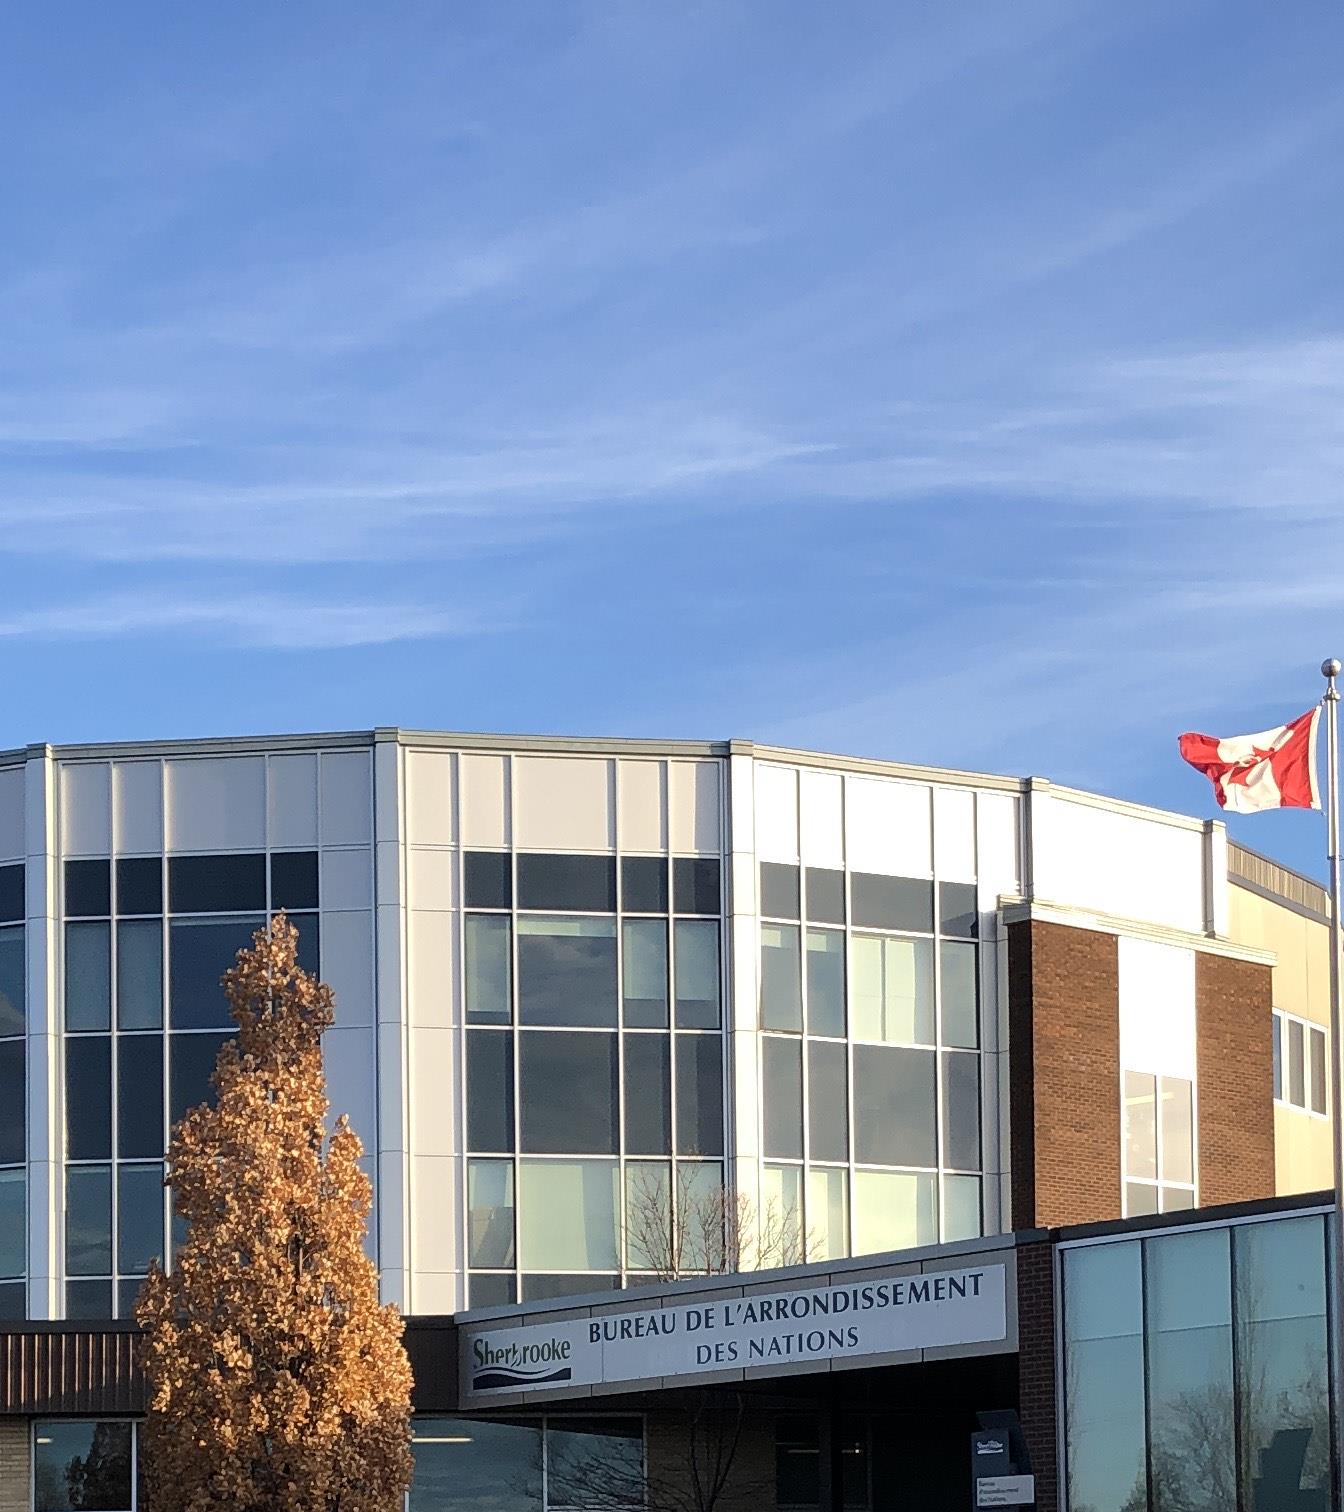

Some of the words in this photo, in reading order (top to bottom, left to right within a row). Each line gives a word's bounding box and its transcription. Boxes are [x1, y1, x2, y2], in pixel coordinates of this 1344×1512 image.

[589, 1312, 676, 1344] BUREAU
[686, 1307, 715, 1332] DE
[724, 1272, 984, 1327] L'ARRONDISSEMENT
[473, 1337, 572, 1368] Sherbrooke
[696, 1341, 738, 1365] DES
[749, 1326, 859, 1359] NATIONS
